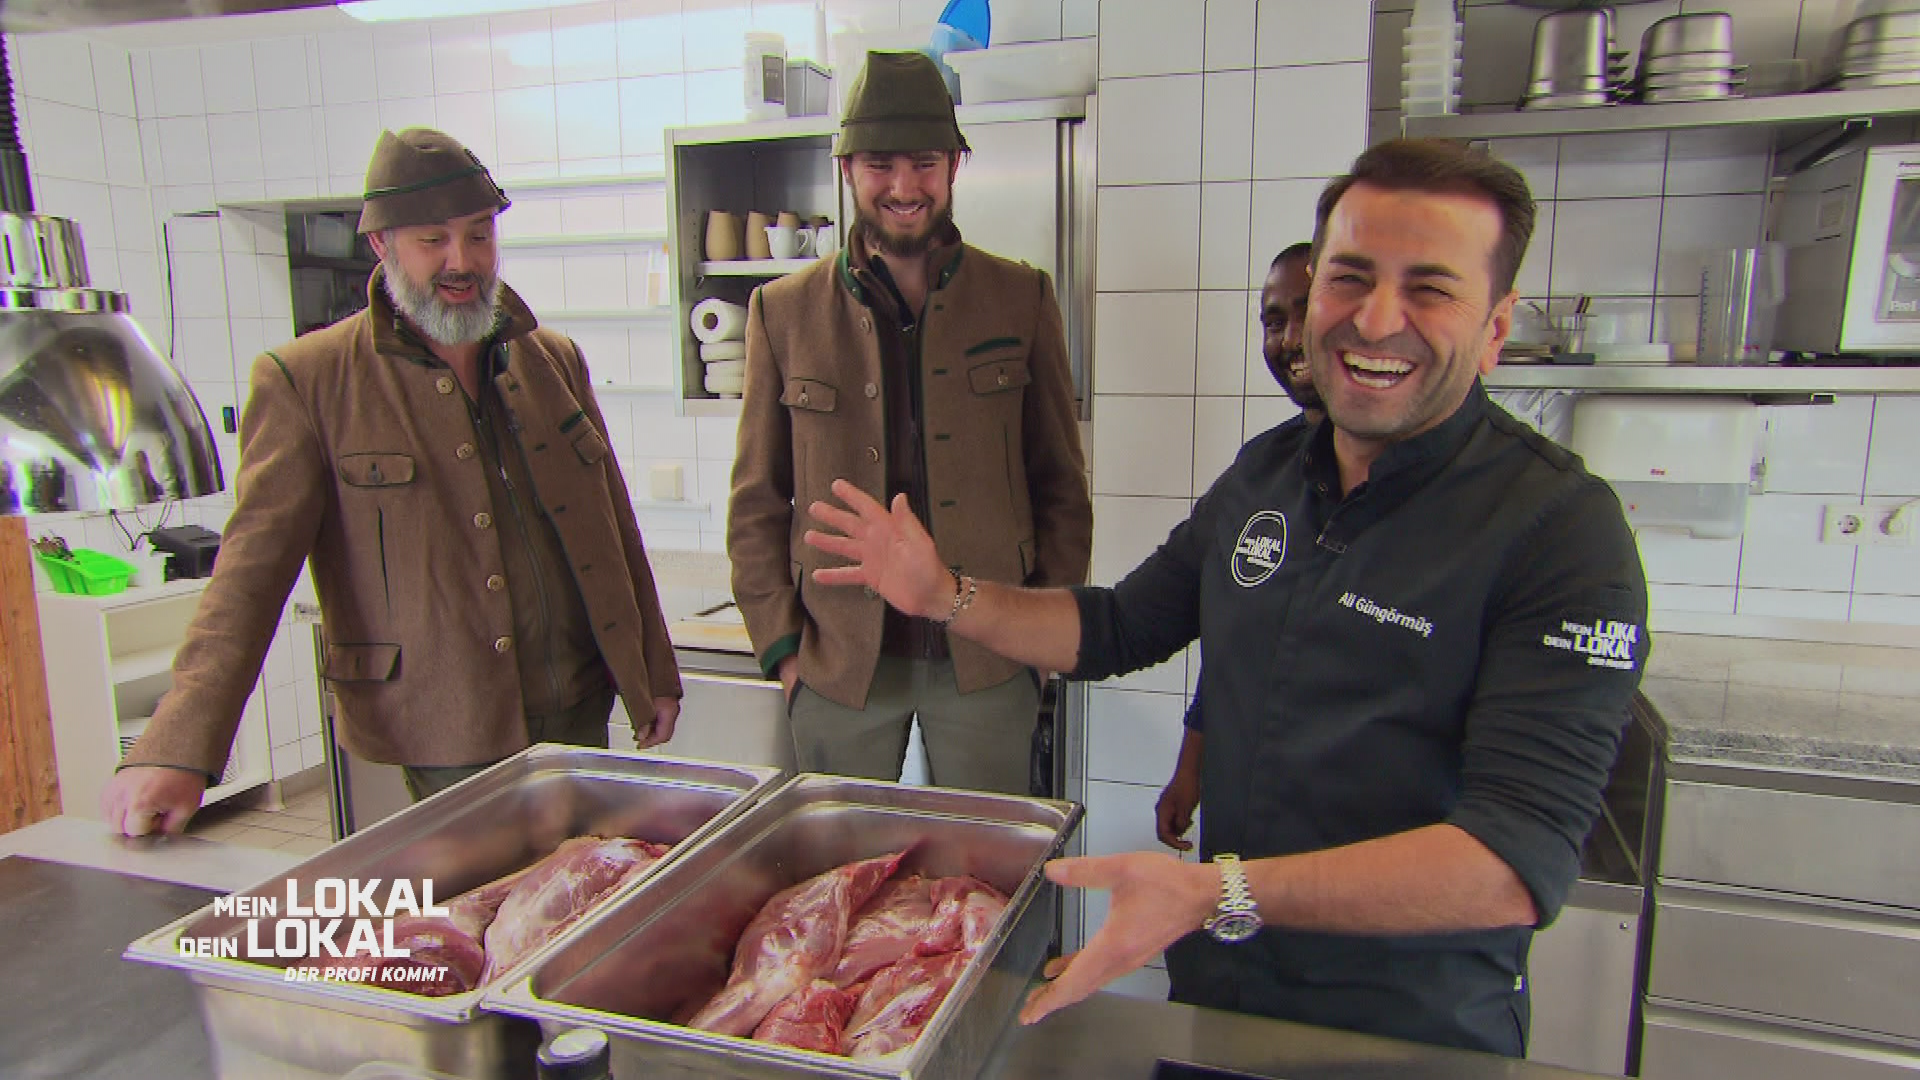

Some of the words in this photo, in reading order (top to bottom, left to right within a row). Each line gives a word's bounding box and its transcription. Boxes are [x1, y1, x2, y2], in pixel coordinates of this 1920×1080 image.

[1338, 592, 1356, 607] Ali
[1355, 597, 1434, 637] Güngörmüş
[1573, 635, 1631, 659] LOKAL
